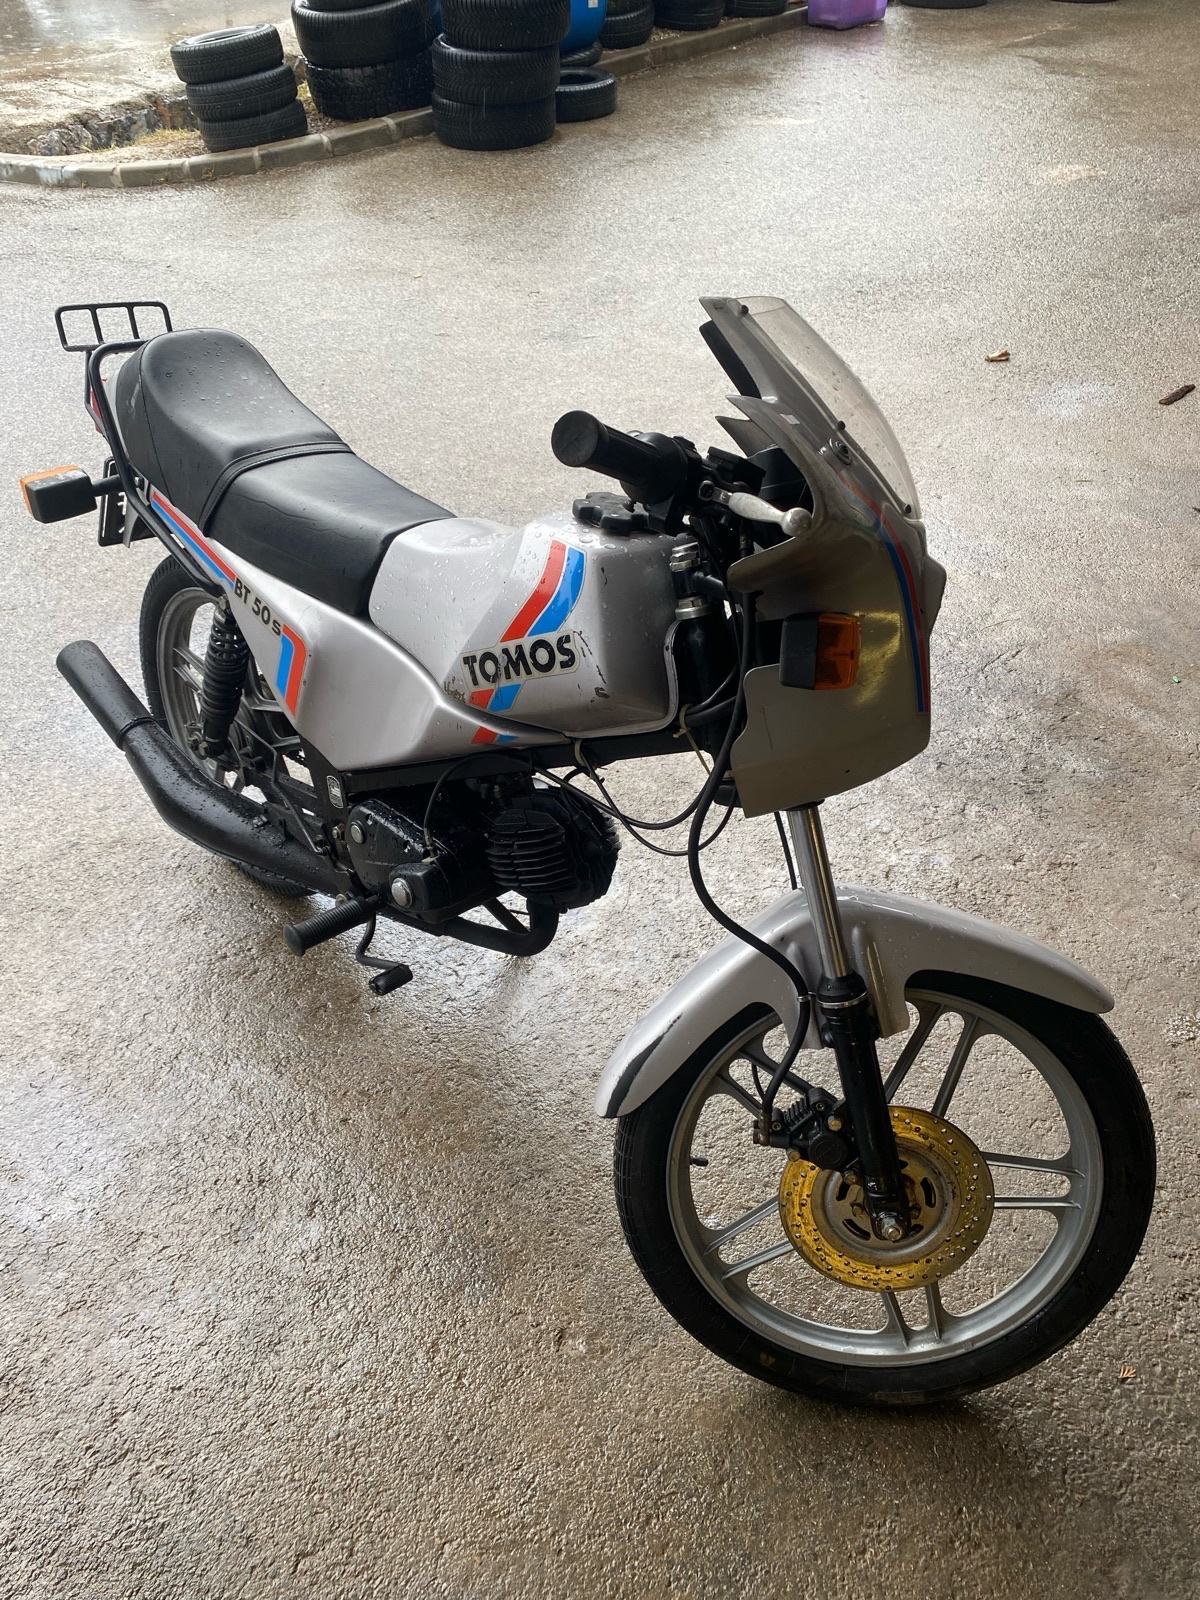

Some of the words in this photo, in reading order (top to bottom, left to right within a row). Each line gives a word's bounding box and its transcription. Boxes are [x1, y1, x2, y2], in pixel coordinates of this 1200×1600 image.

[234, 578, 251, 604] BT
[252, 597, 271, 625] 50
[463, 634, 576, 686] TOMOS
